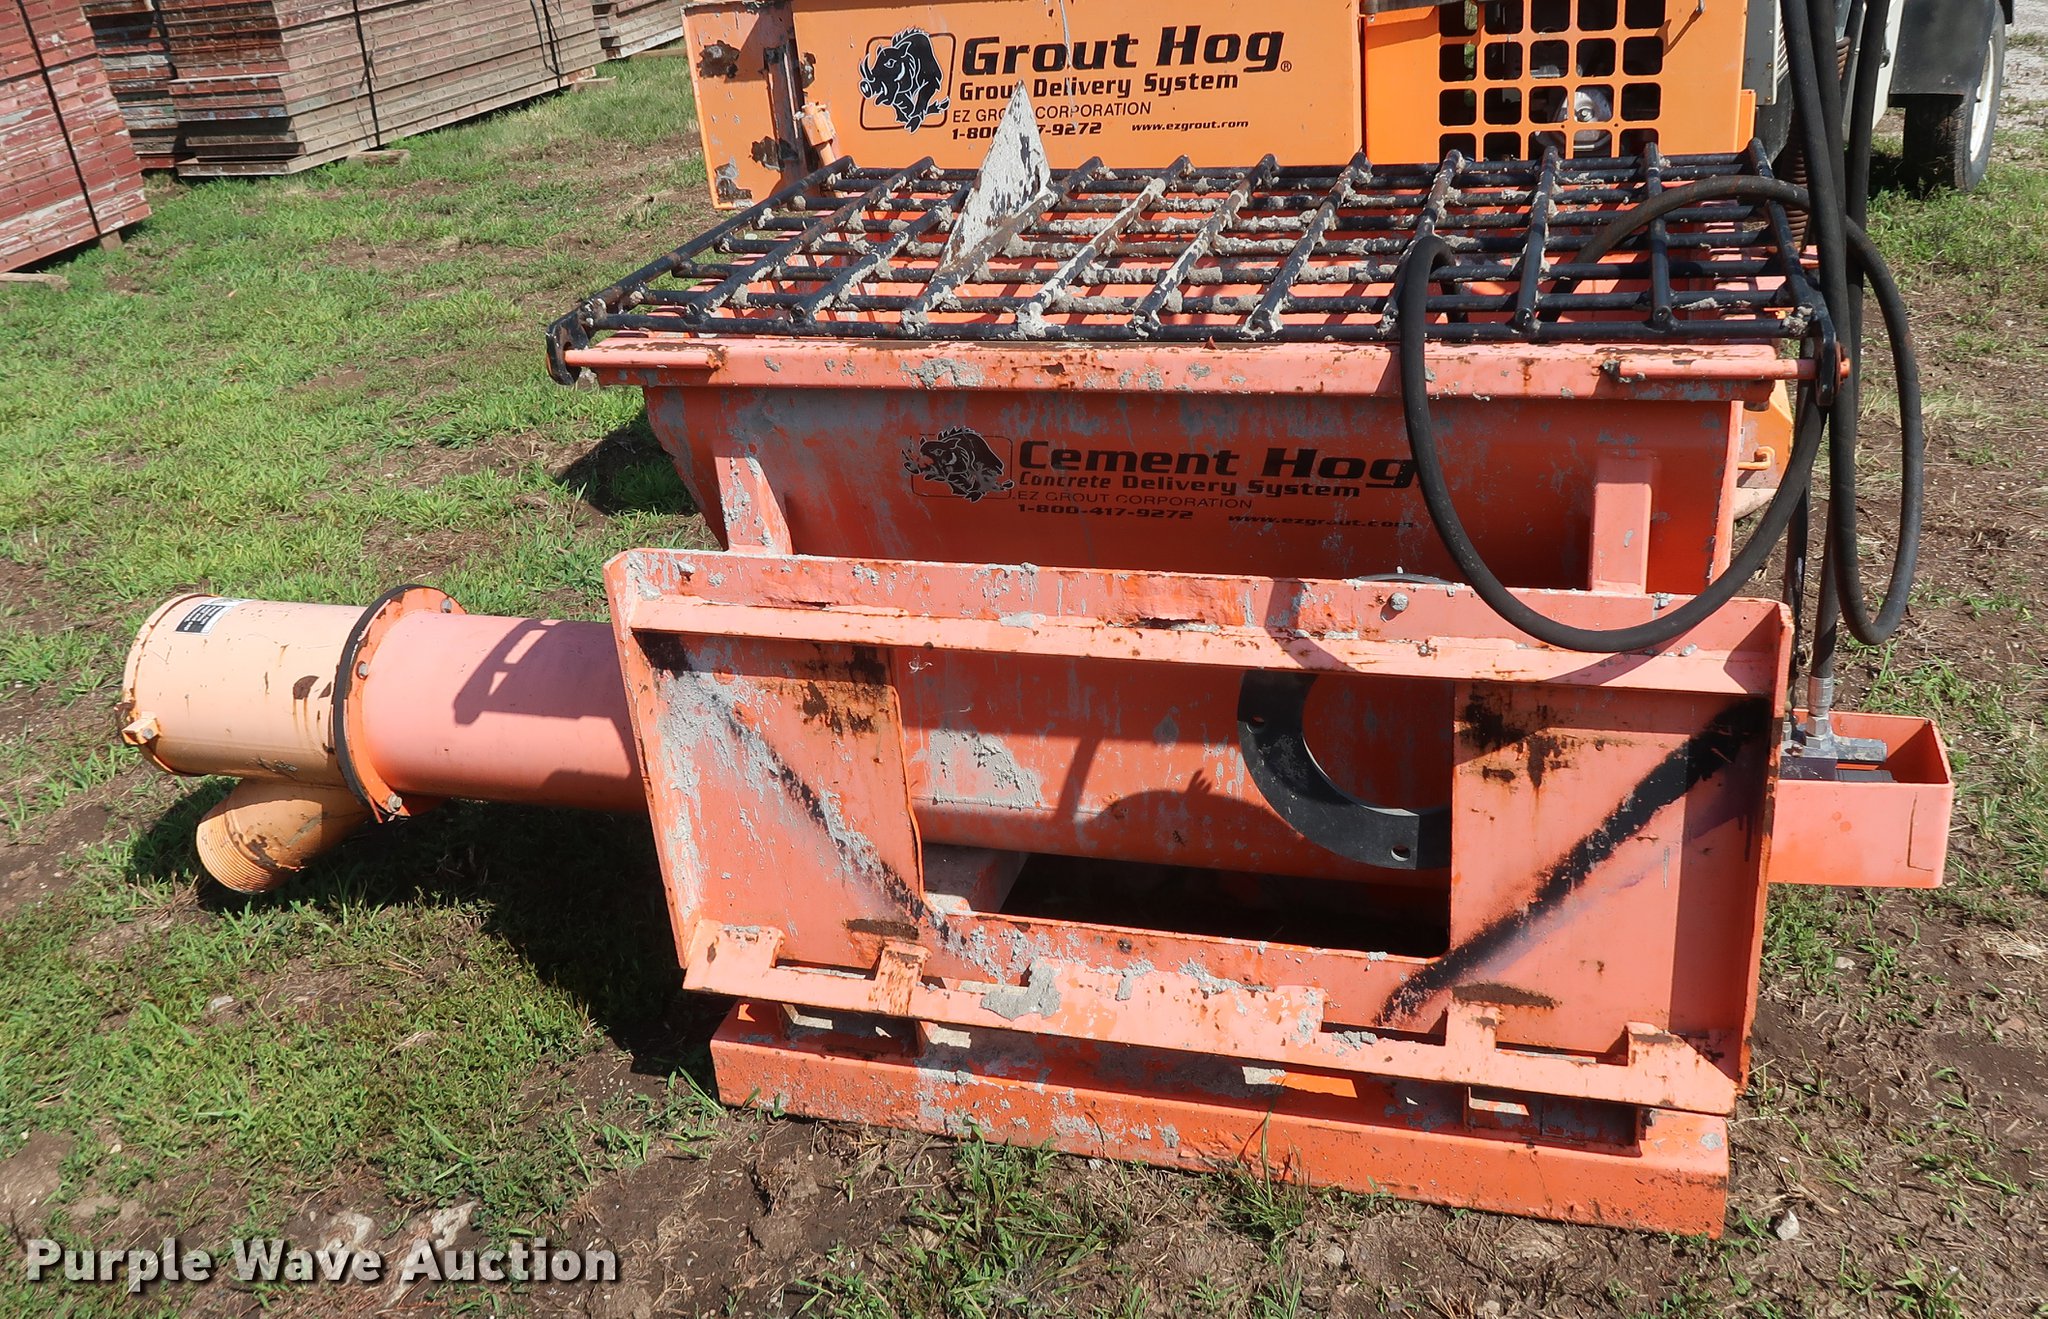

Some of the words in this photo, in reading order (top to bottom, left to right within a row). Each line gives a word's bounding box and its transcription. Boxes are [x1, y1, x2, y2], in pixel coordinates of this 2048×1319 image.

[961, 34, 1139, 77] Grout
[960, 81, 1019, 100] Grou
[1033, 77, 1131, 98] Delivery
[1144, 72, 1238, 96] System
[953, 109, 971, 122] EZ
[976, 107, 1007, 121] GRO
[1035, 101, 1152, 119] CORPORATION
[1131, 120, 1249, 132] www.ezgrout.com
[1018, 440, 1240, 476] Cement
[1261, 447, 1418, 488] Hog
[1020, 471, 1111, 489] Concrete
[1122, 475, 1237, 496] Delivery
[1247, 479, 1360, 498] System
[1017, 490, 1040, 500] EZ
[1045, 491, 1110, 503] GROUT
[1115, 494, 1252, 509] CORPORATION
[1018, 503, 1194, 520] 1-800-417-9272
